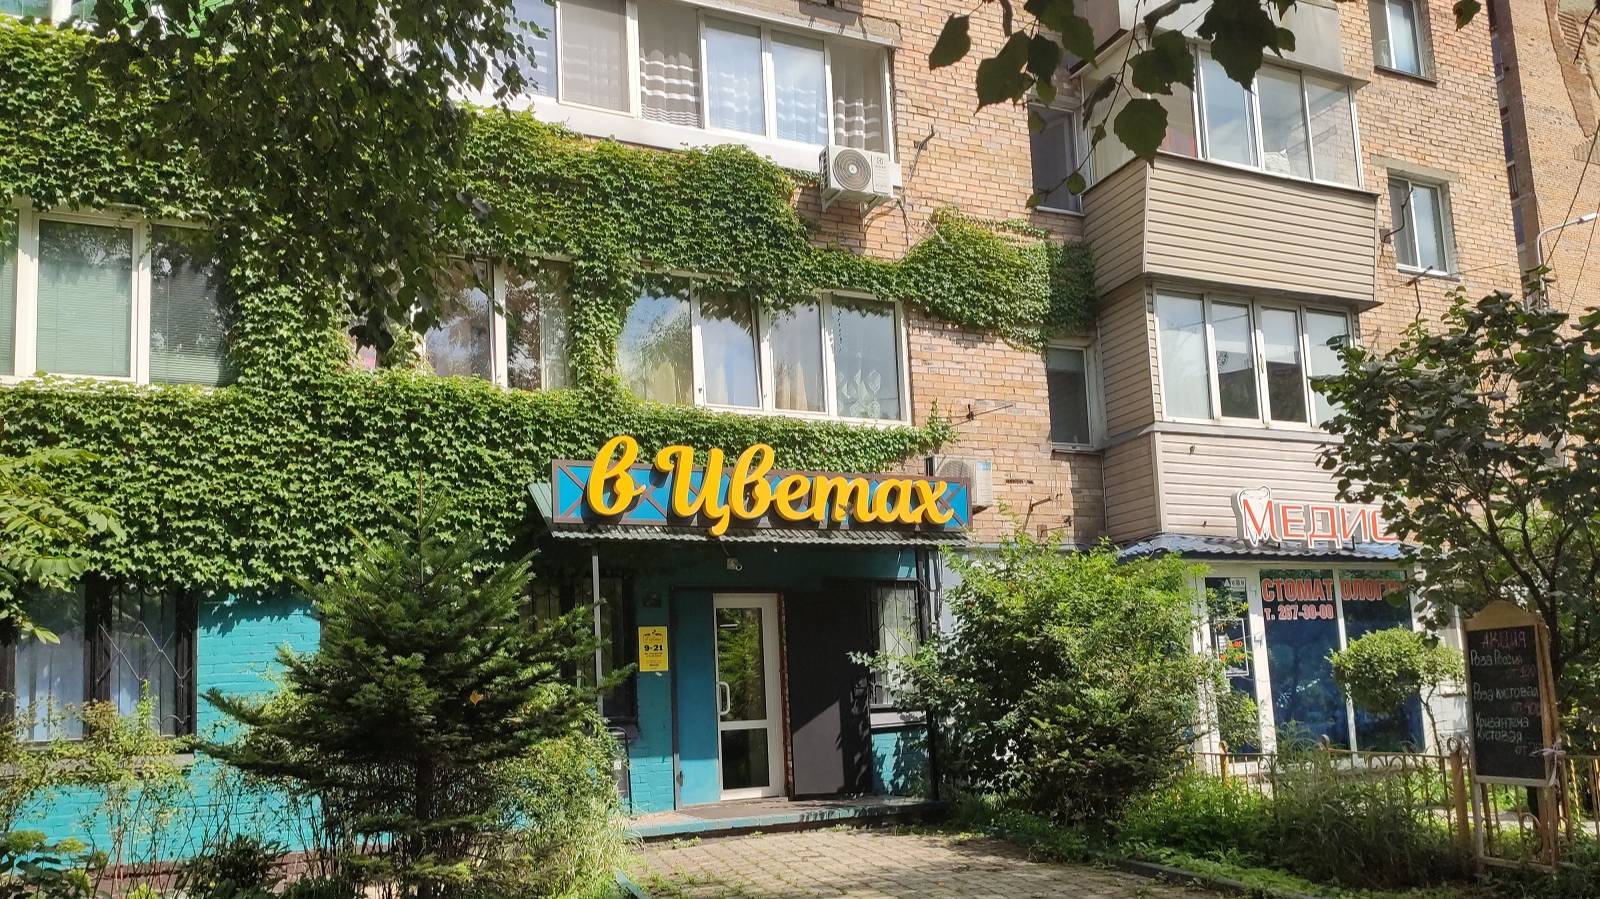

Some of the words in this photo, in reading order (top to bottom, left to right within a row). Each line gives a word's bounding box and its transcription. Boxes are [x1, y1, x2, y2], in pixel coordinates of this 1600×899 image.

[656, 444, 954, 536] Цветах
[1278, 604, 1334, 620] 267-30-00
[1470, 649, 1493, 666] Роза
[1473, 682, 1494, 702] Роза
